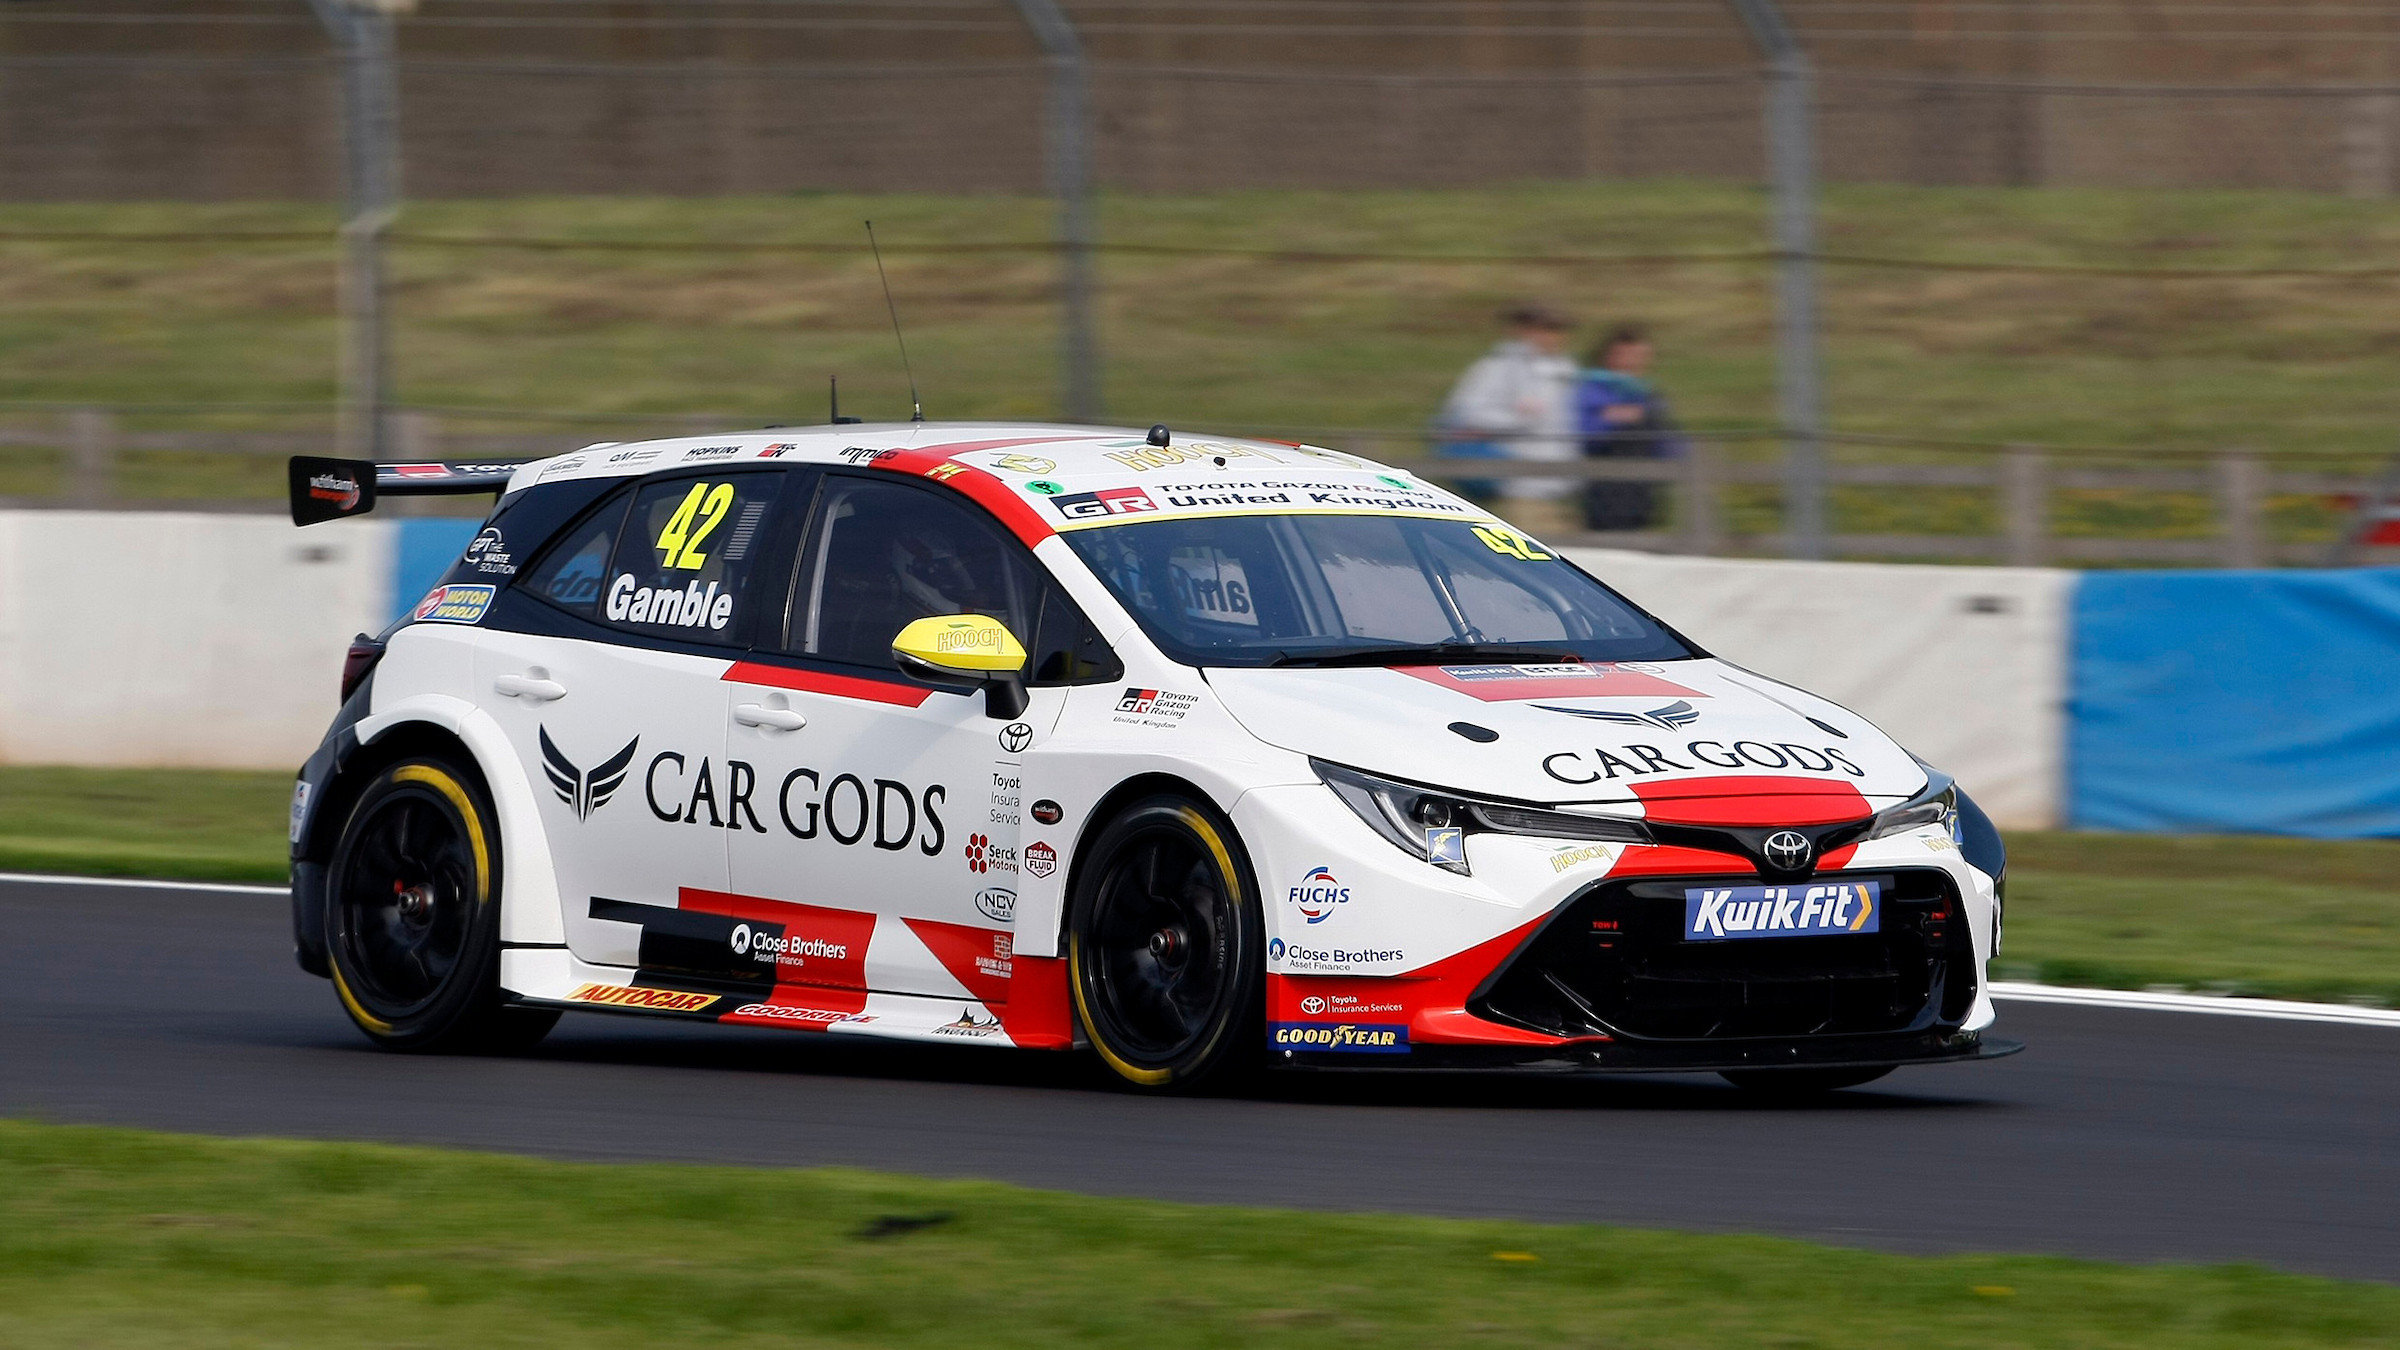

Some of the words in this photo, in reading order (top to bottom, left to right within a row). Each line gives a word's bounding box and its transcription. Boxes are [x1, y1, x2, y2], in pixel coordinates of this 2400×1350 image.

[687, 445, 743, 457] HOPKINS
[1154, 481, 1254, 492] TOYOTA
[1262, 481, 1348, 492] GAZOO
[1353, 484, 1433, 499] Racing
[1057, 496, 1160, 519] GR
[1168, 493, 1291, 507] United
[1309, 493, 1464, 512] Kingdom
[655, 482, 735, 570] 42
[1470, 526, 1552, 560] 42
[483, 553, 511, 563] WASTE
[478, 563, 518, 575] SOLUTION
[446, 590, 490, 605] MOTOR
[606, 573, 733, 630] Gamble
[433, 605, 481, 619] WORLD
[938, 629, 1003, 654] HOOCH
[1115, 694, 1155, 713] GR
[1160, 691, 1199, 702] TOYOTA
[1155, 700, 1191, 709] GAZOO
[1150, 708, 1185, 719] Racing
[1113, 716, 1140, 725] United
[1142, 719, 1177, 729] Kingdom
[1542, 744, 1695, 784] CAR
[1687, 741, 1865, 778] GODS
[993, 773, 1021, 790] Toyot
[646, 751, 767, 834] CAR
[779, 768, 946, 856] GODS
[990, 791, 1020, 806] Insura
[989, 845, 1017, 860] Serck
[1027, 850, 1053, 860] BREAK
[1550, 845, 1613, 873] HOOCH
[1029, 860, 1053, 870] FLUID
[984, 893, 1017, 911] NCV
[1289, 888, 1350, 903] FUCHS
[1592, 921, 1611, 929] TOW
[752, 932, 788, 953] Close
[791, 935, 847, 959] Brothers
[754, 951, 775, 963] Asset
[776, 953, 804, 966] Finance
[1289, 945, 1329, 961] Close
[1334, 949, 1404, 963] Brothers
[1289, 959, 1312, 969] Asset
[1314, 962, 1351, 971] Finance
[571, 985, 710, 1010] AUTOCAR
[1331, 996, 1357, 1005] Toyota
[1331, 1005, 1369, 1013] Insurance
[1371, 1003, 1402, 1012] Services
